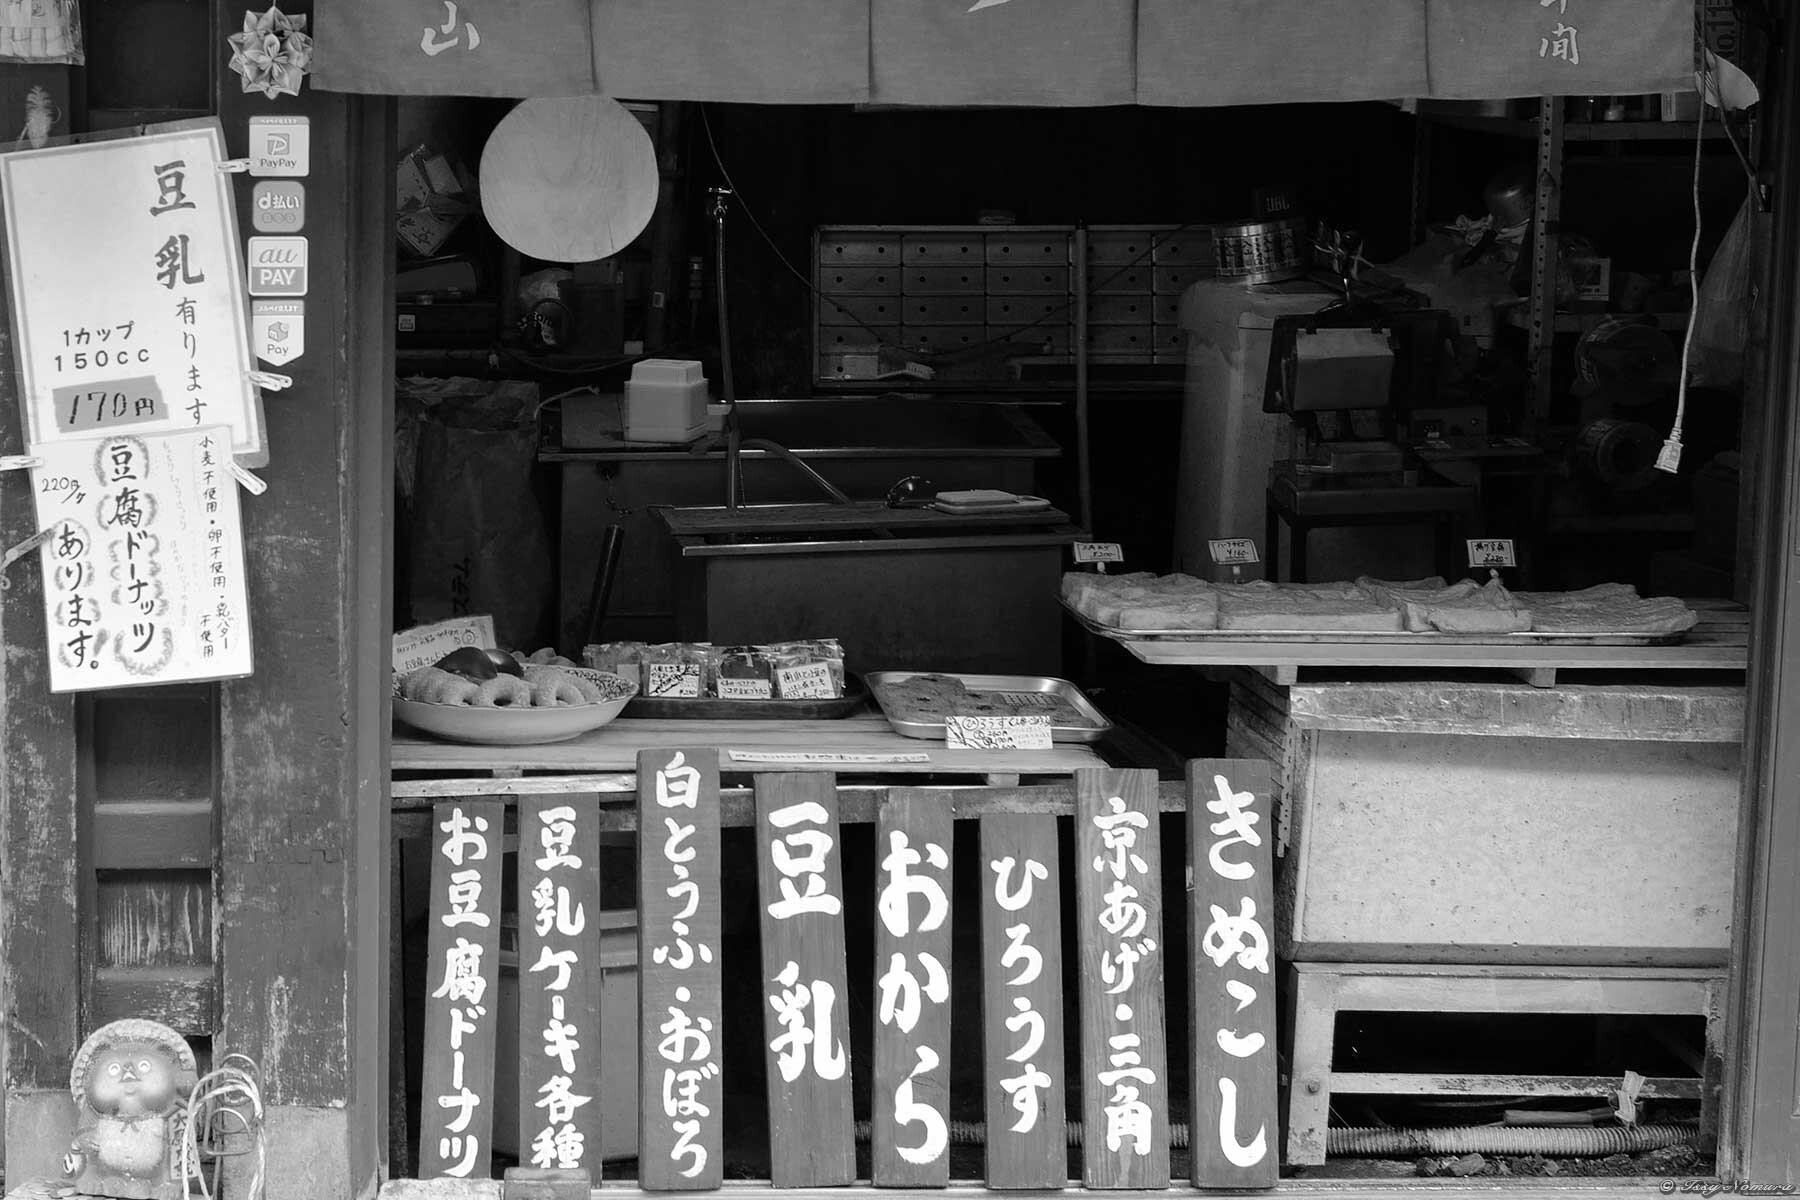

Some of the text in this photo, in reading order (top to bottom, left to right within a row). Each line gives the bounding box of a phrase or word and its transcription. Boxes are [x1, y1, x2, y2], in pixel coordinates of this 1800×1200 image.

[1539, 0, 1580, 65] 間
[260, 158, 297, 169] PayPay
[258, 191, 300, 210] d払い
[258, 248, 298, 265] au
[260, 268, 296, 286] PAY
[54, 348, 150, 372] 150cc
[266, 343, 289, 356] Pay
[68, 391, 155, 424] 170円
[768, 802, 845, 1082] 豆乳
[432, 808, 490, 1177] お豆腐ドーナツ
[529, 807, 591, 1168] 豆乳ケーキ各種
[879, 830, 949, 1164] おから
[991, 857, 1051, 1133] ひろうす
